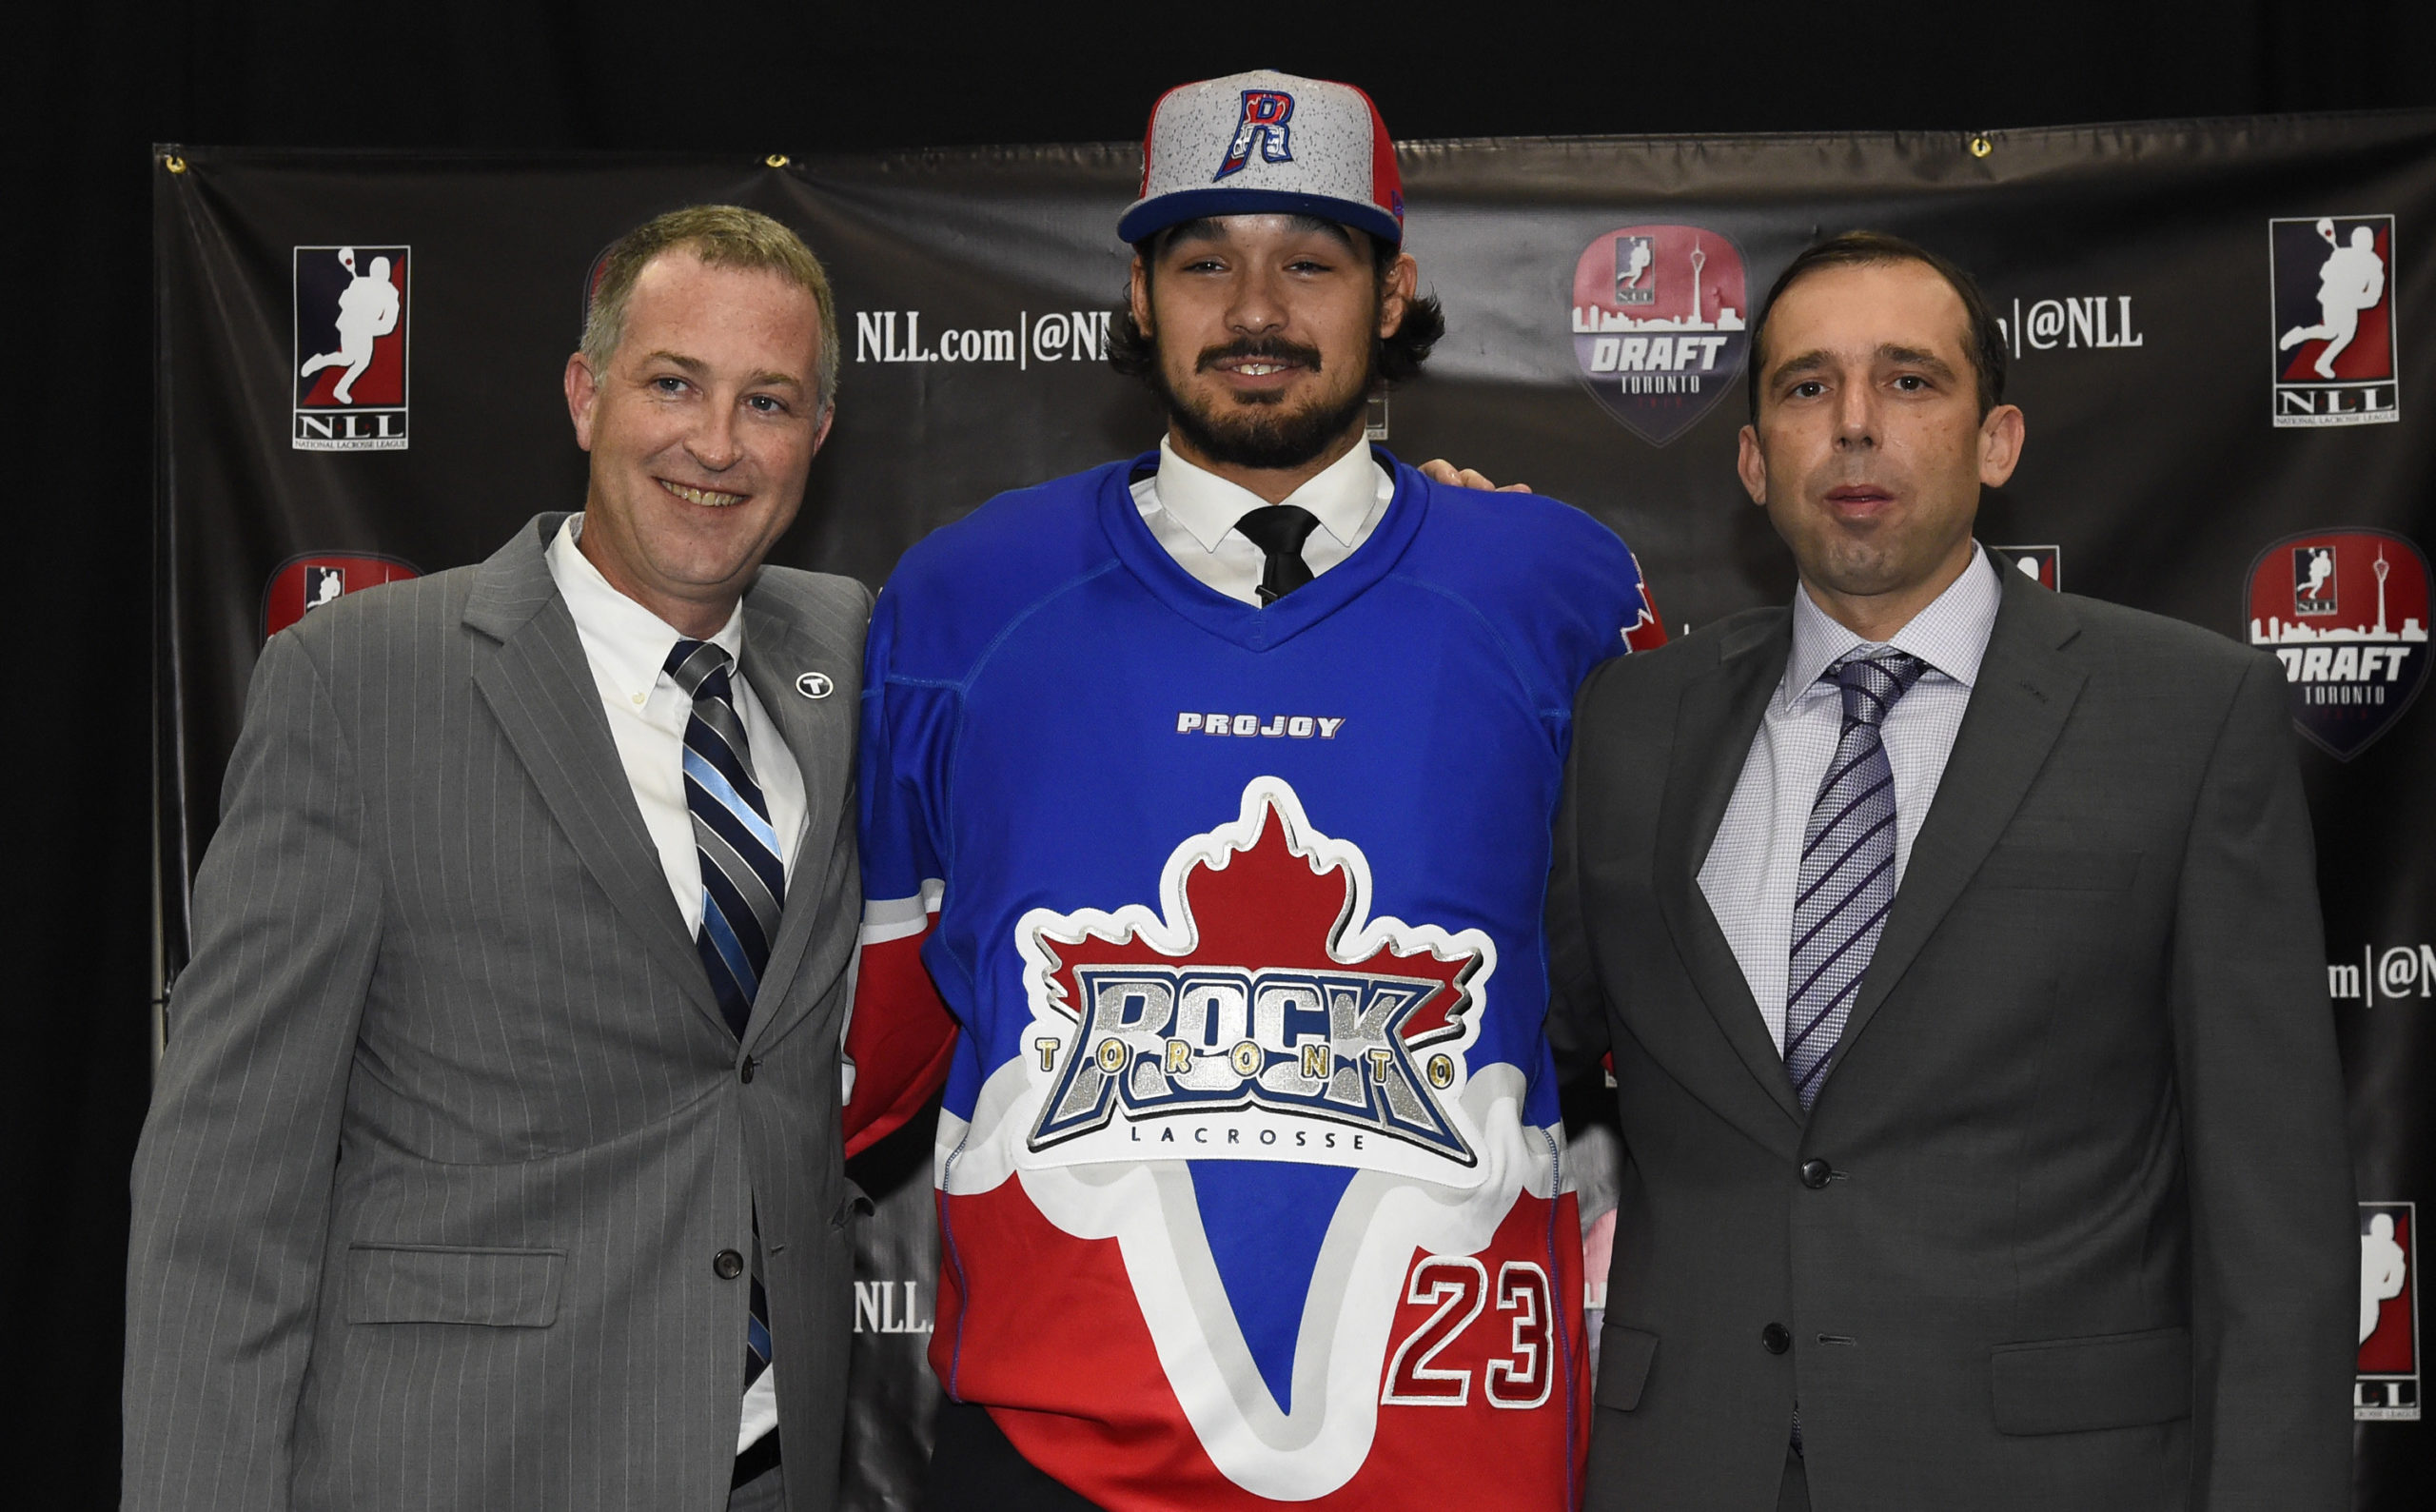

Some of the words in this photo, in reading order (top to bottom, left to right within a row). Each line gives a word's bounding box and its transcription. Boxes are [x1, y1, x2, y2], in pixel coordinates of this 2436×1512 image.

[1591, 336, 1727, 372] DRAFT
[1621, 375, 1700, 394] TORONTO
[2279, 387, 2394, 415] NLL
[299, 415, 404, 439] NLL
[295, 440, 334, 449] NATIONAL
[336, 441, 373, 449] LACROSSE
[376, 440, 406, 448] LEAGUE
[2276, 646, 2411, 682] DRAFT
[2304, 685, 2385, 704] TORONTO
[1176, 712, 1346, 739] PROJOY
[1035, 1037, 1455, 1090] TORONTO
[1037, 970, 1463, 1153] ROCK
[1130, 1126, 1365, 1151] LACROSSE
[1380, 1254, 1554, 1410] 23
